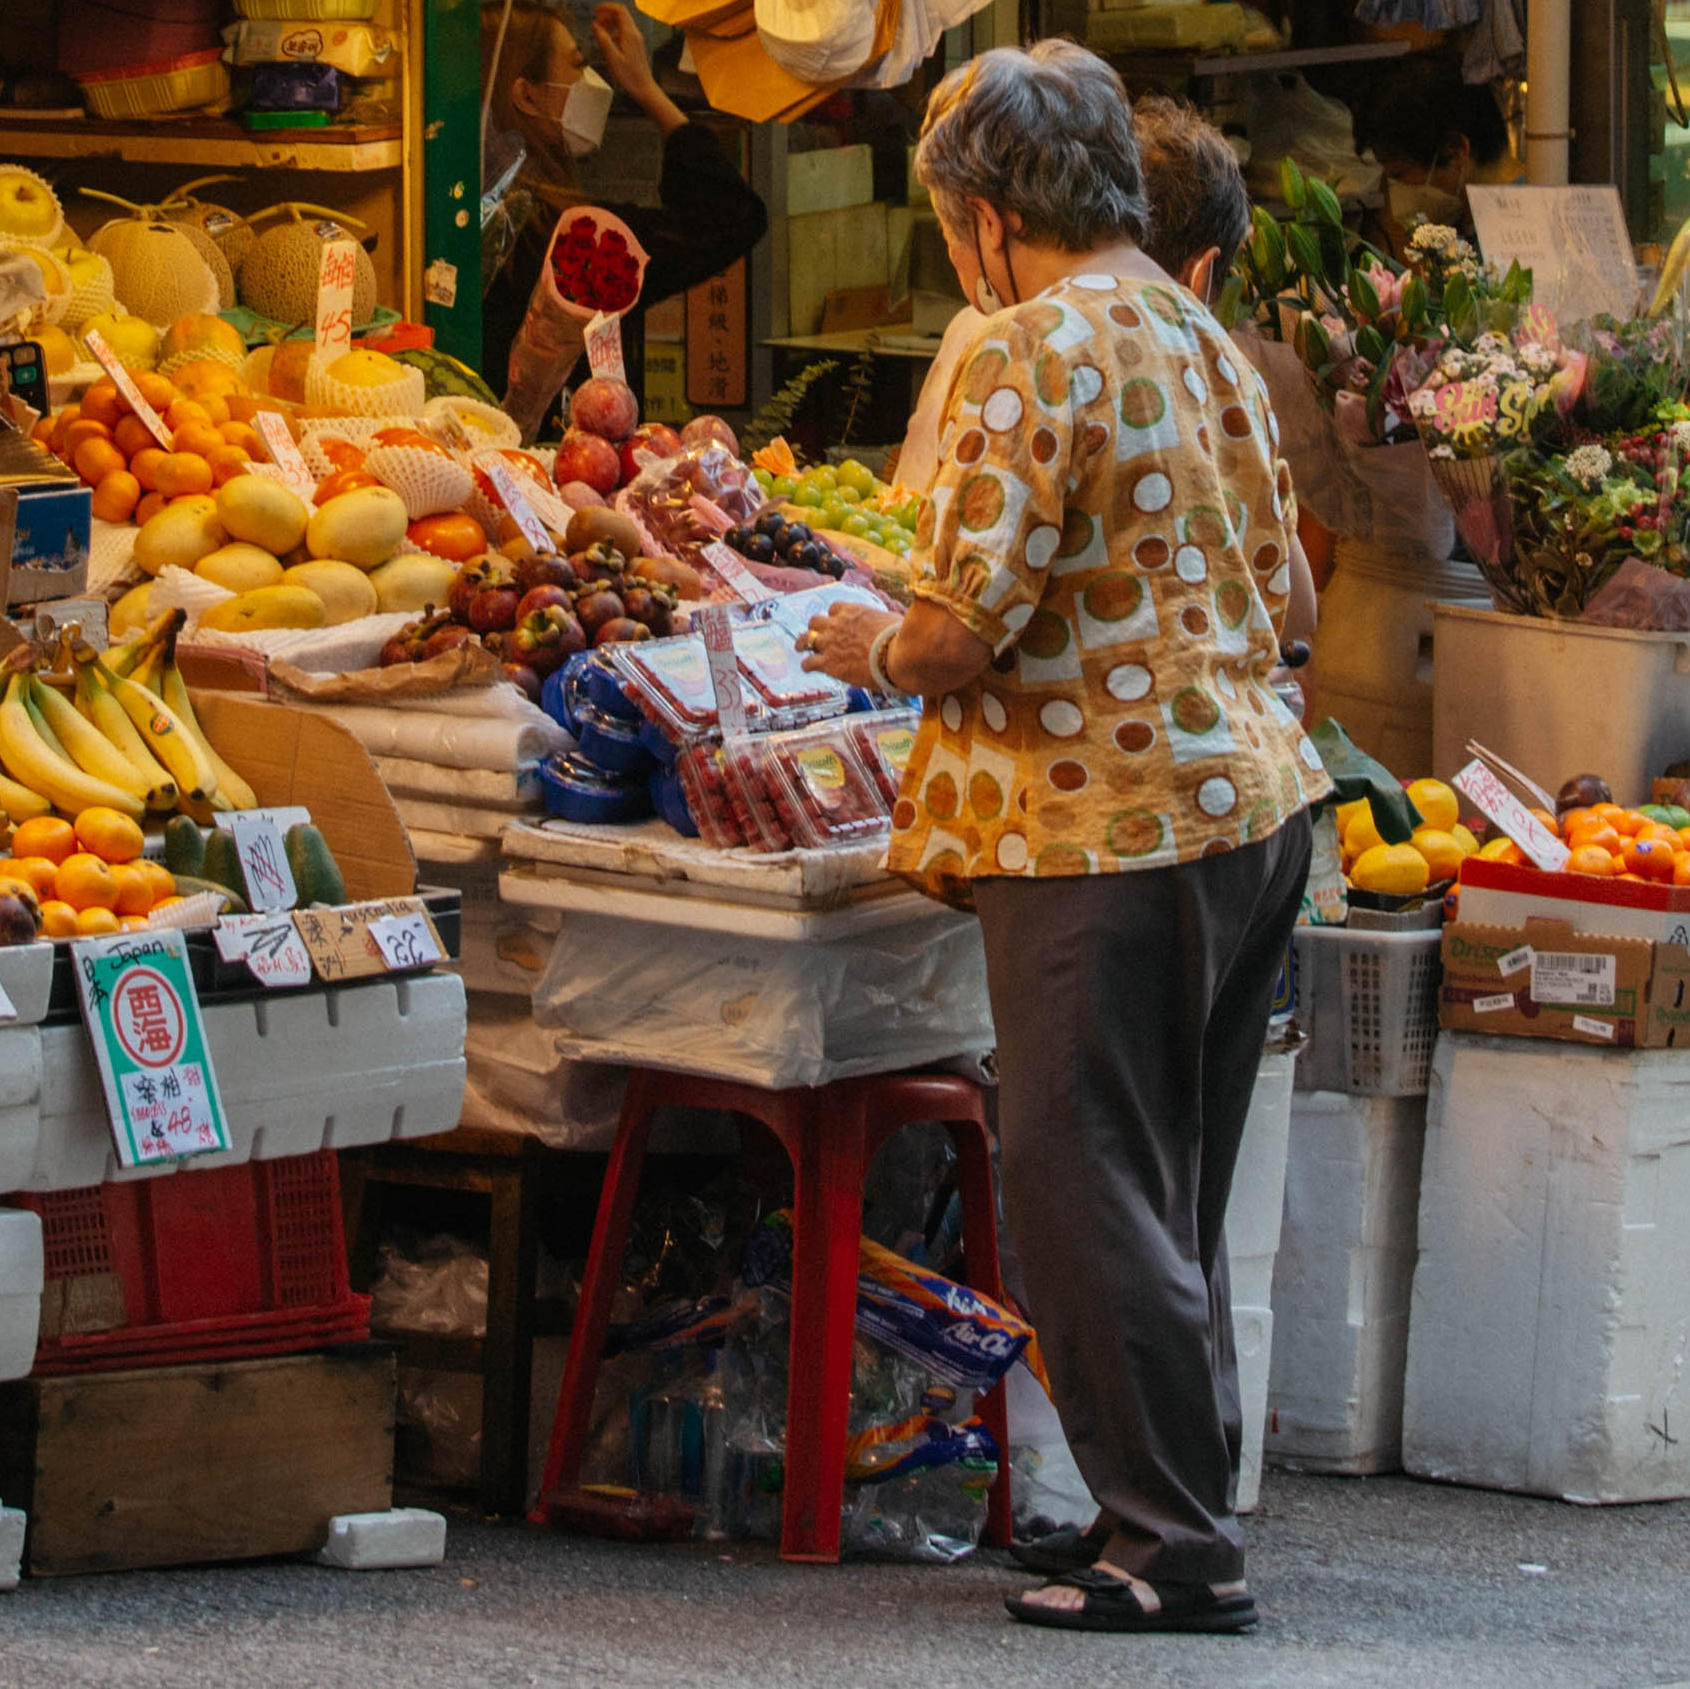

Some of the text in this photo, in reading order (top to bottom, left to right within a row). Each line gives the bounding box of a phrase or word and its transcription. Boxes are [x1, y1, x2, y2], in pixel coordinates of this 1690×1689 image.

[321, 311, 351, 347] 45
[107, 939, 165, 970] Japan
[82, 956, 109, 1012] 日本
[127, 984, 173, 1054] 西海
